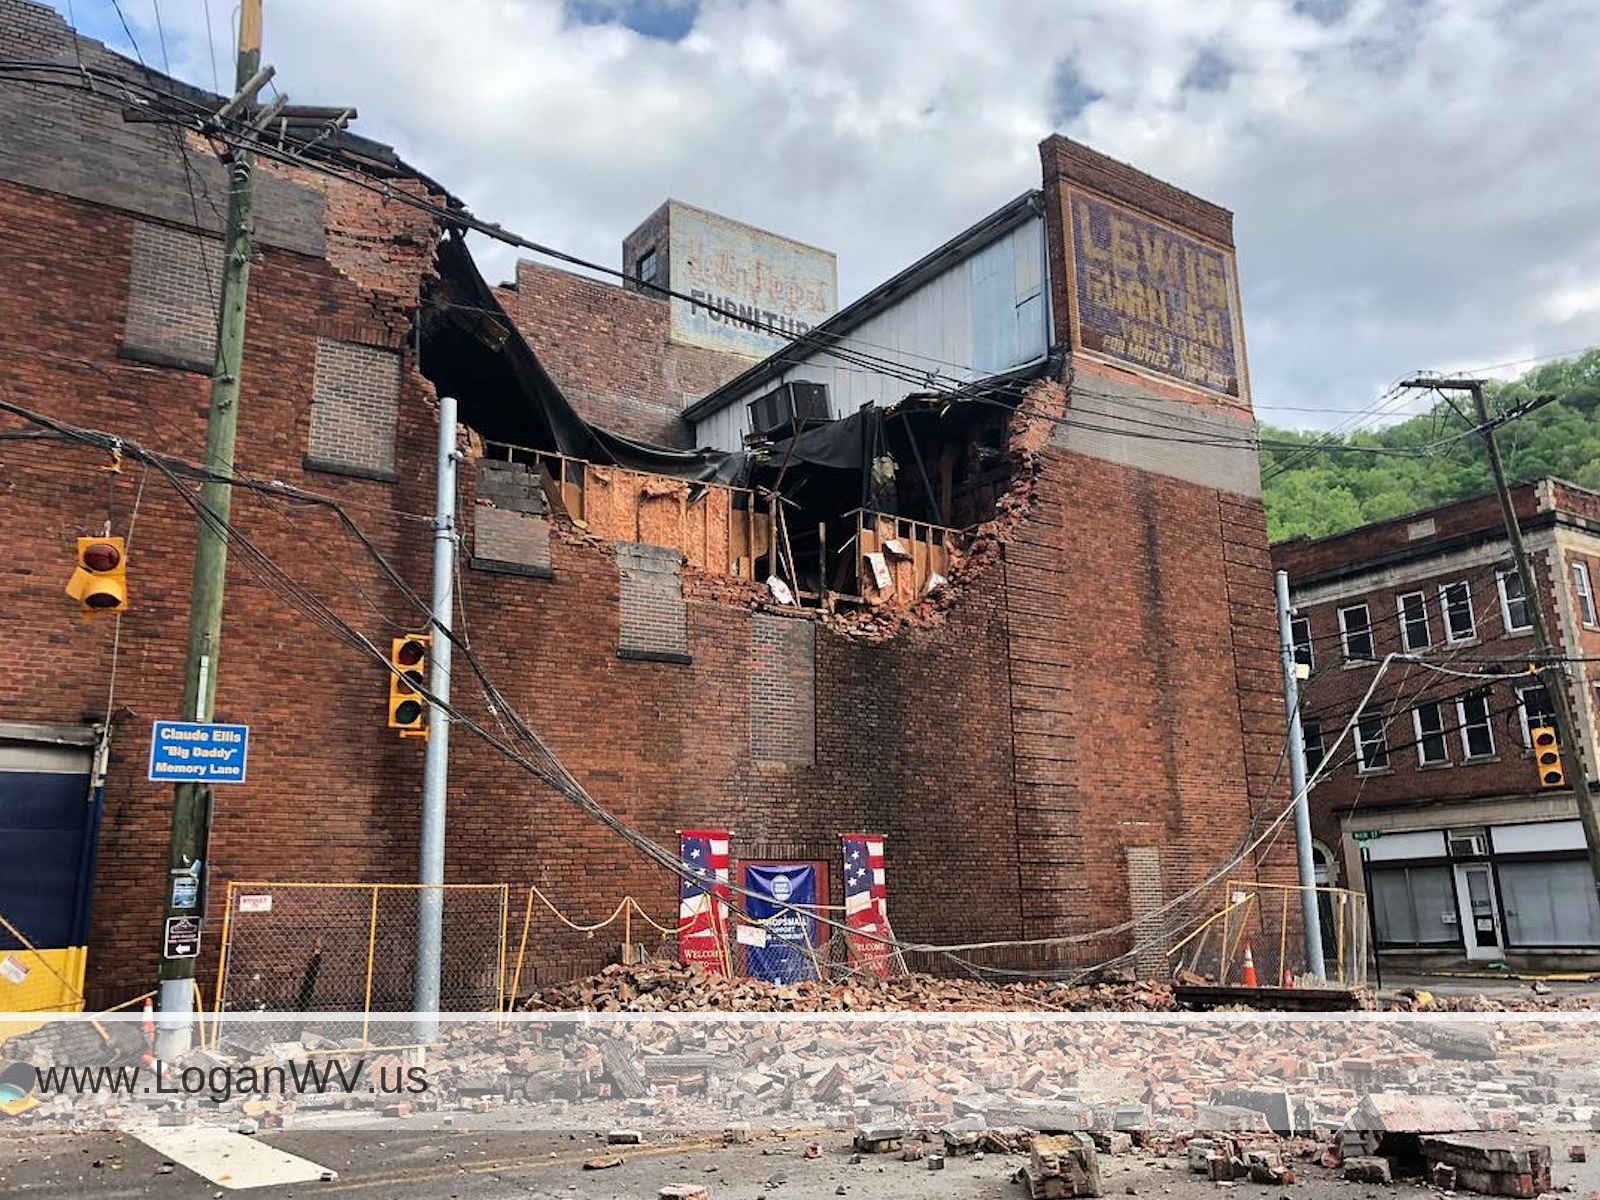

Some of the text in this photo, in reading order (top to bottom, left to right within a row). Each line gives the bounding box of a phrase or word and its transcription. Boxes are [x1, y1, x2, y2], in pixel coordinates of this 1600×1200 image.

[691, 289, 816, 337] FURNITUR
[161, 728, 241, 743] Claude Ellis
[155, 762, 240, 775] Memory Lane
